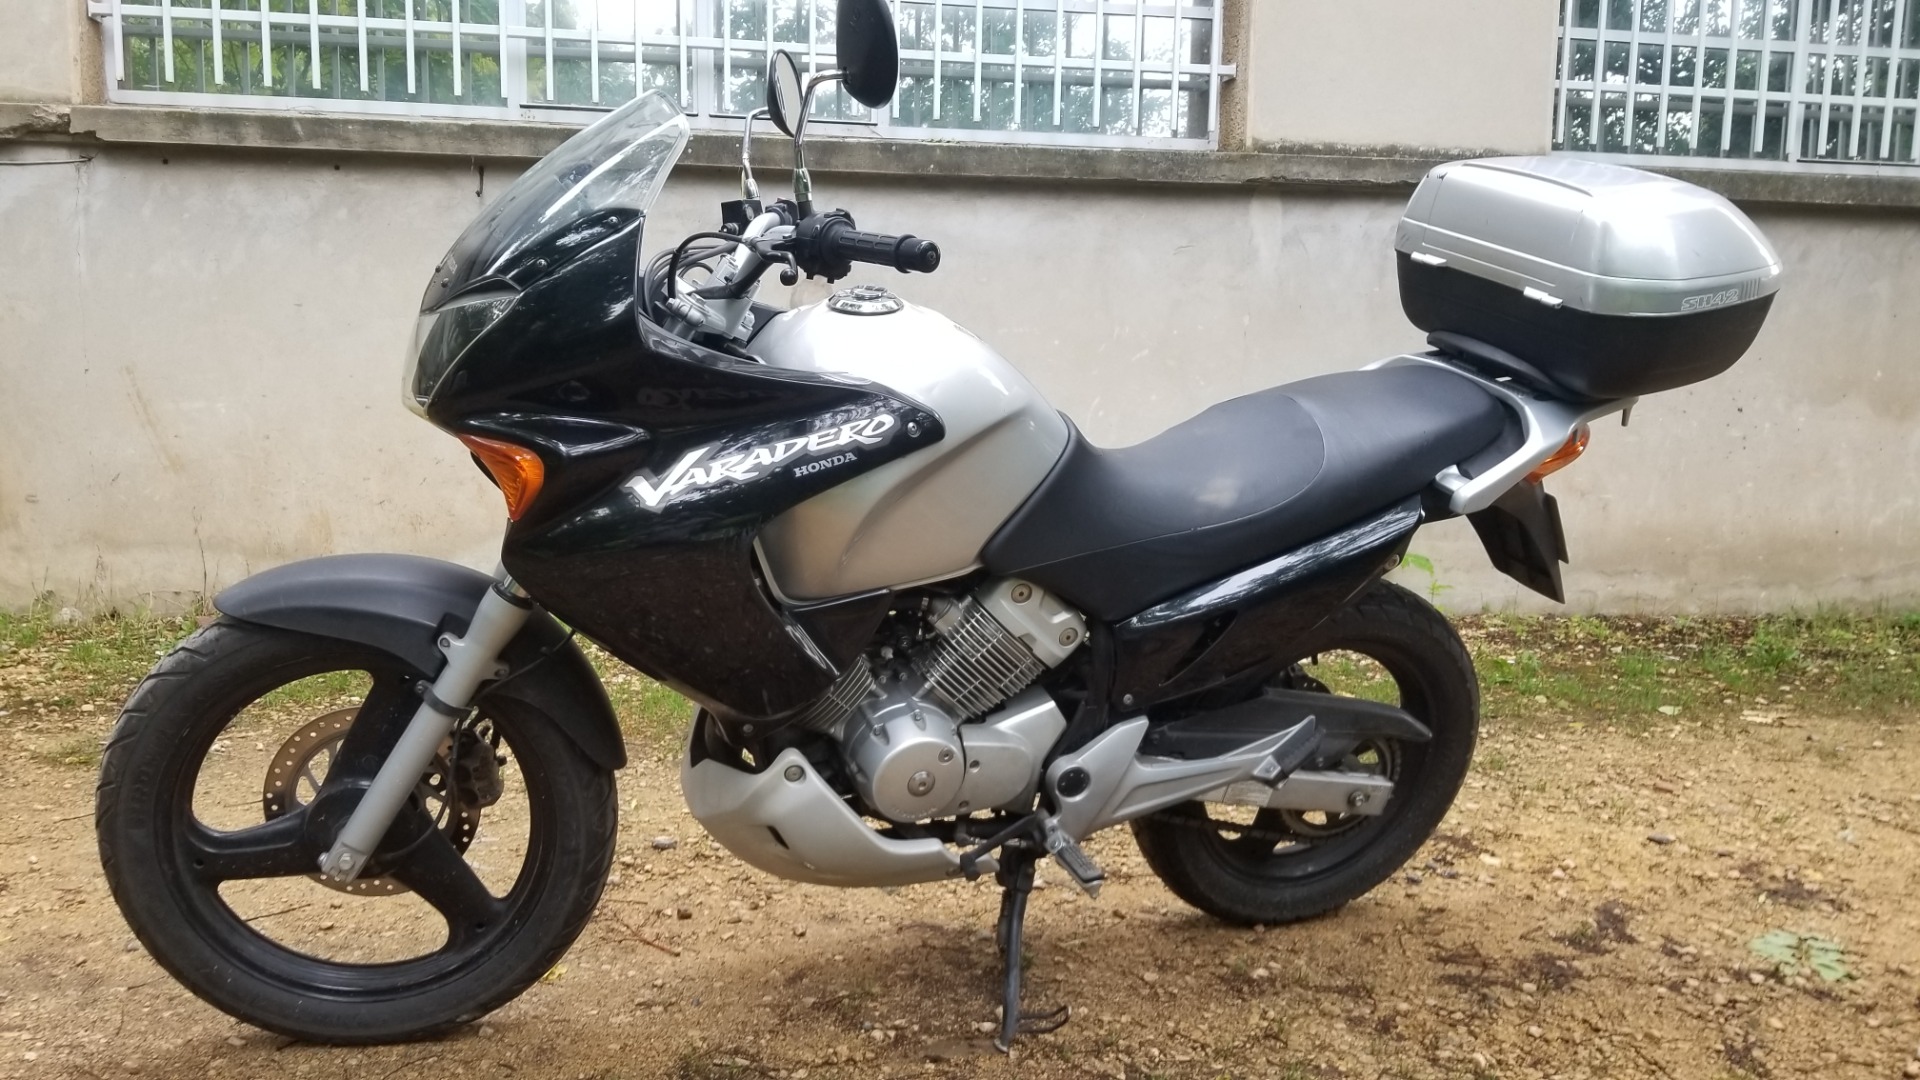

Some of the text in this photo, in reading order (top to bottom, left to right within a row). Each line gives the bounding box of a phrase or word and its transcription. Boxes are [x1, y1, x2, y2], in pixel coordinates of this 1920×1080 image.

[1681, 288, 1739, 311] SH42
[625, 414, 896, 507] VARADERO
[794, 452, 858, 477] HONDA
